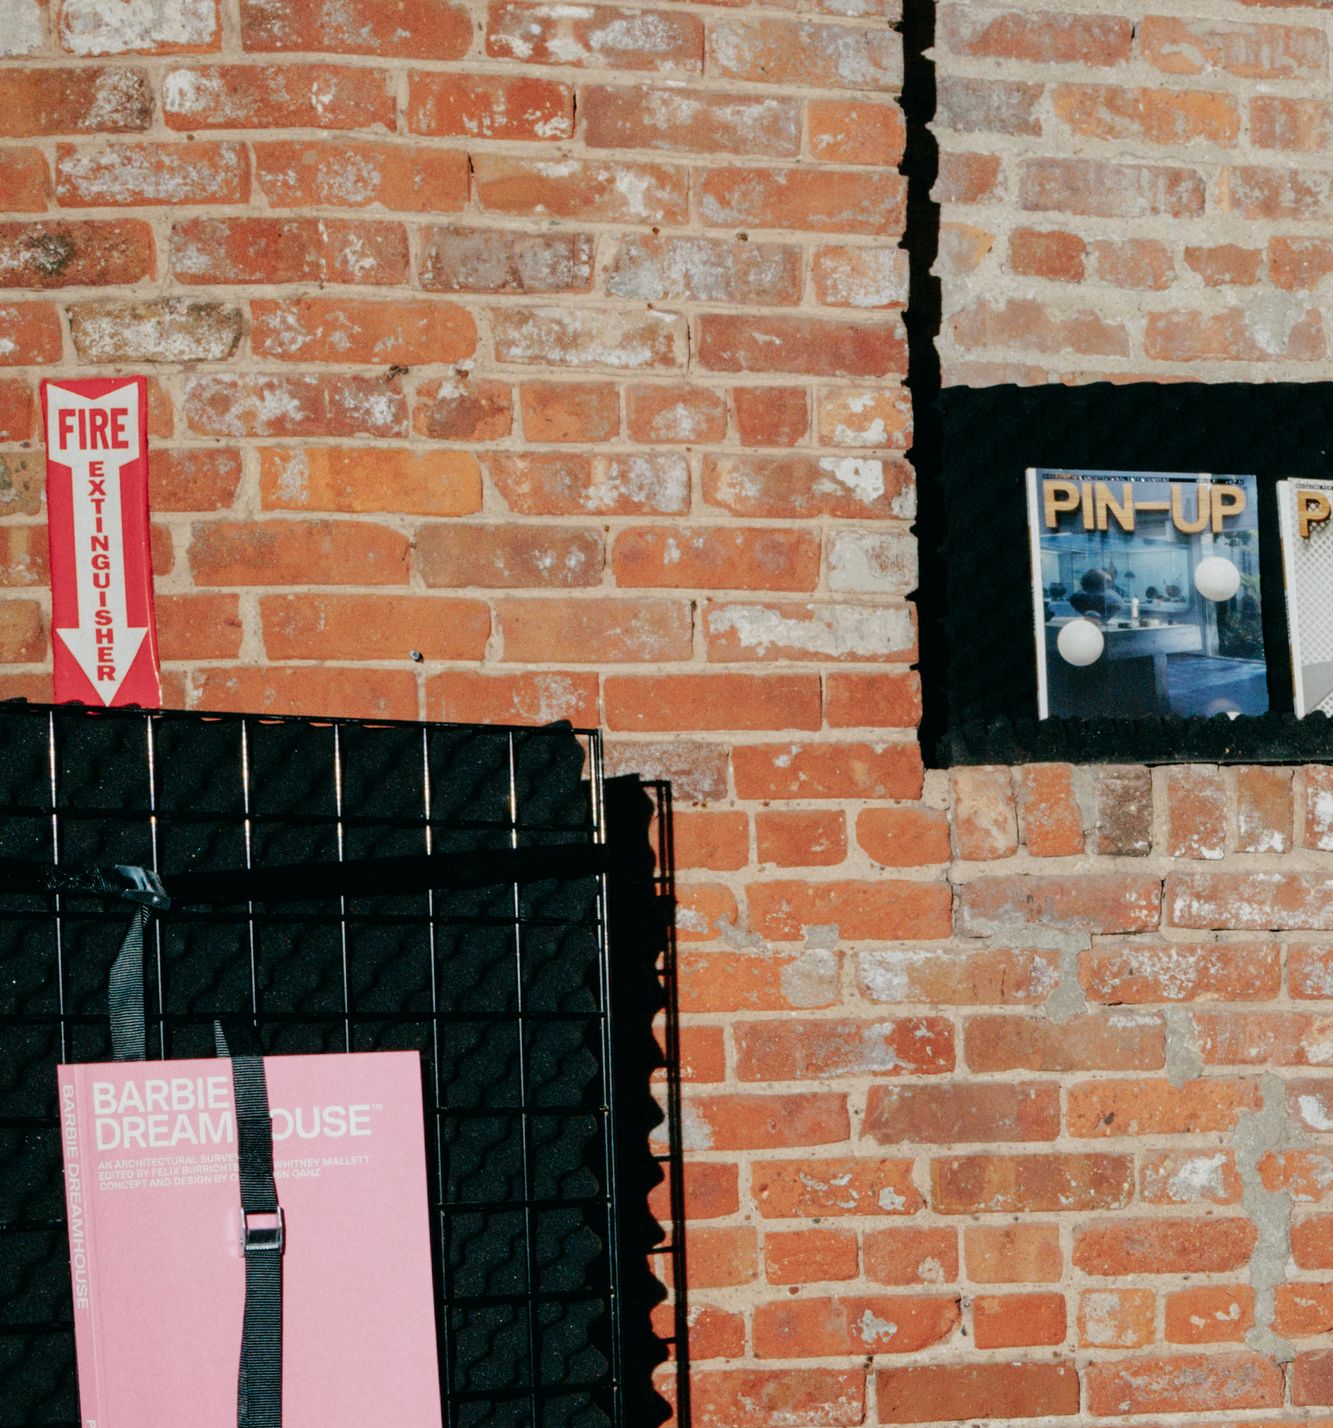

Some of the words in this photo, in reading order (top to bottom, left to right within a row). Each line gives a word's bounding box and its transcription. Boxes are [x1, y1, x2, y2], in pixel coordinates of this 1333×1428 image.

[58, 408, 129, 450] FIRE
[88, 461, 115, 681] EXTINGUISHER
[92, 1076, 231, 1115] BARBIE
[62, 1084, 79, 1158] BARBIE
[99, 1160, 114, 1170] AN
[115, 1156, 198, 1169] ARCHITECTURAL
[200, 1153, 240, 1164] SURVEY
[99, 1169, 134, 1181] EDITED
[136, 1169, 150, 1179] BY
[152, 1166, 180, 1177] FELIX
[323, 1155, 369, 1166] MALLETT
[100, 1179, 147, 1191] CONCEPT
[149, 1177, 173, 1187] AND
[175, 1175, 214, 1186] DESIGN
[216, 1174, 230, 1183] BY
[292, 1168, 321, 1178] GANZ
